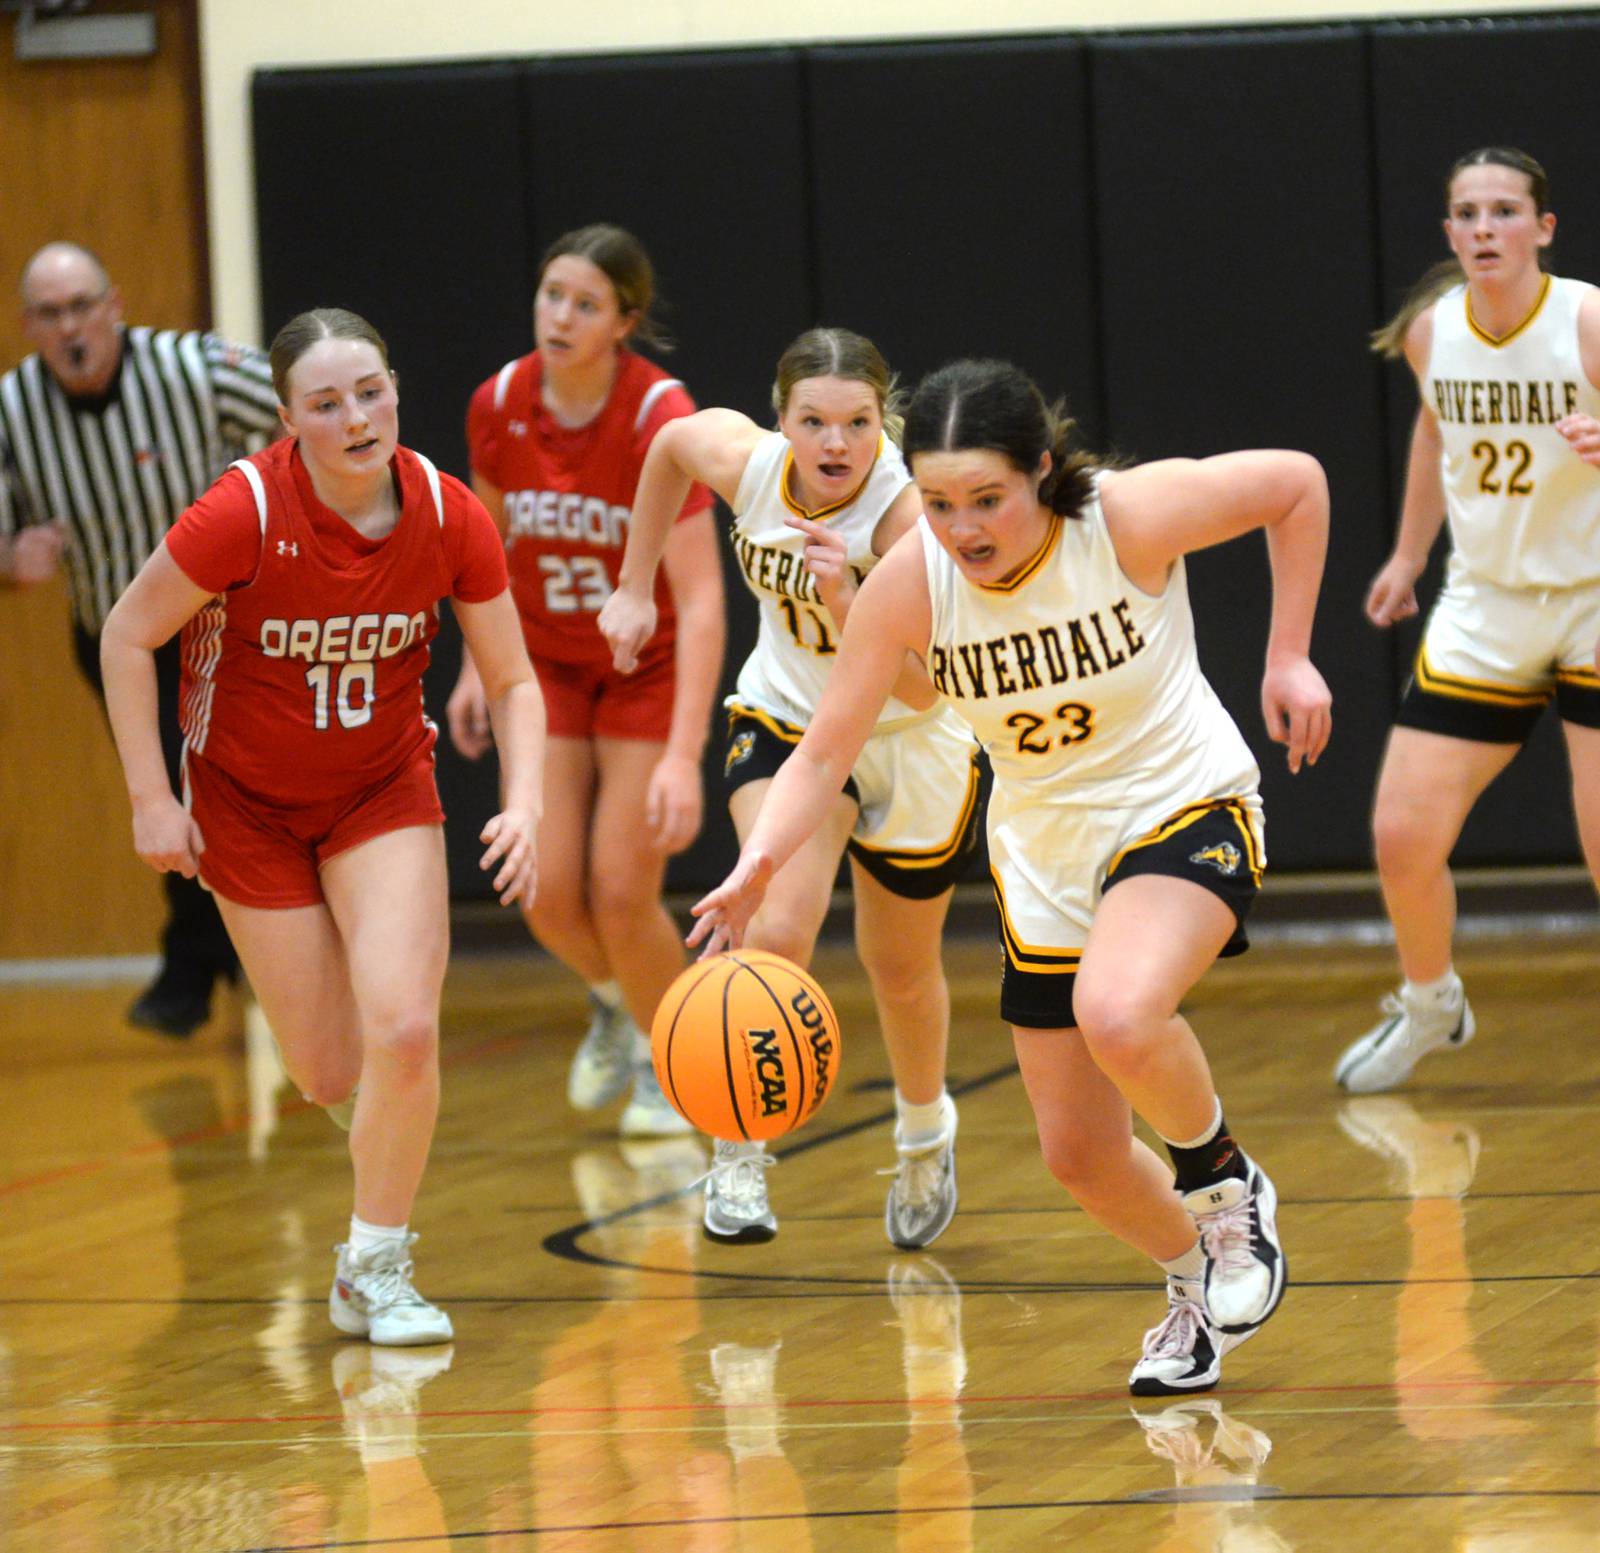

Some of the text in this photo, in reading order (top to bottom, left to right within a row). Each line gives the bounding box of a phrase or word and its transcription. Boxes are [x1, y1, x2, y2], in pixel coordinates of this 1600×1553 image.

[1433, 378, 1577, 424] RIVERDALE
[1472, 439, 1535, 496] 22
[537, 554, 614, 613] 23
[260, 610, 427, 663] OREGON
[779, 597, 838, 656] 11
[932, 598, 1146, 699] RIVERDALE
[305, 662, 376, 730] 10
[1006, 701, 1096, 755] 23
[748, 1028, 788, 1118] NCAA
